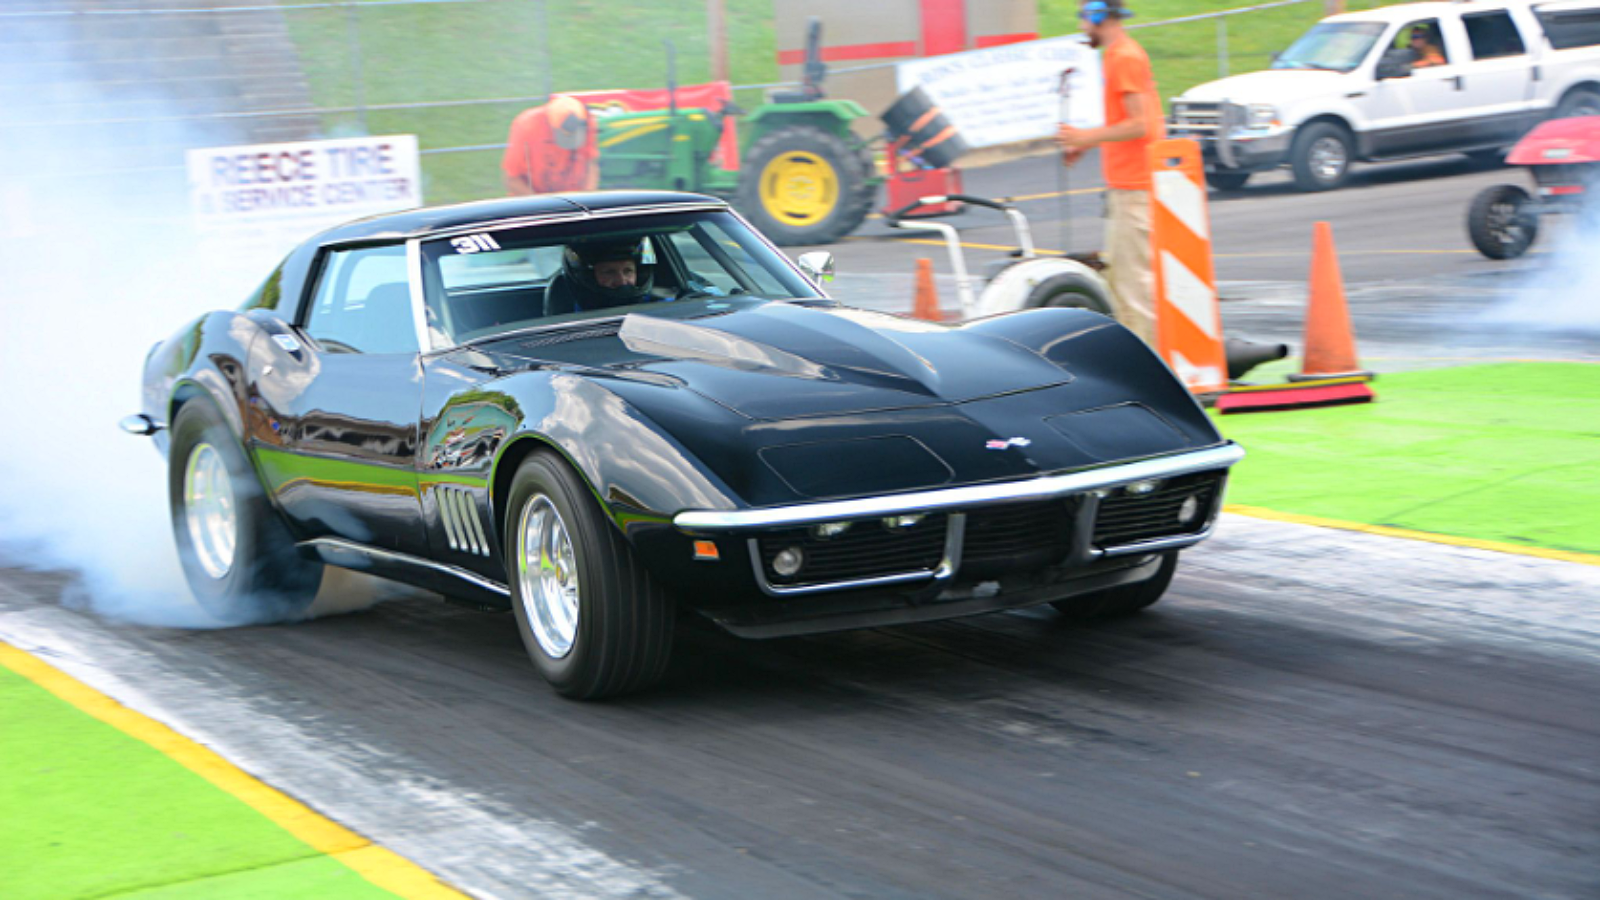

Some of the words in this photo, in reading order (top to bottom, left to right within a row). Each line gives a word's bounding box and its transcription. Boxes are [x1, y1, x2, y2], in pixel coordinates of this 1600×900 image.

[211, 150, 316, 187] REECE
[323, 144, 396, 178] TIRE
[221, 183, 316, 213] SERVICE
[321, 178, 413, 205] CENTER
[450, 233, 501, 254] 311
